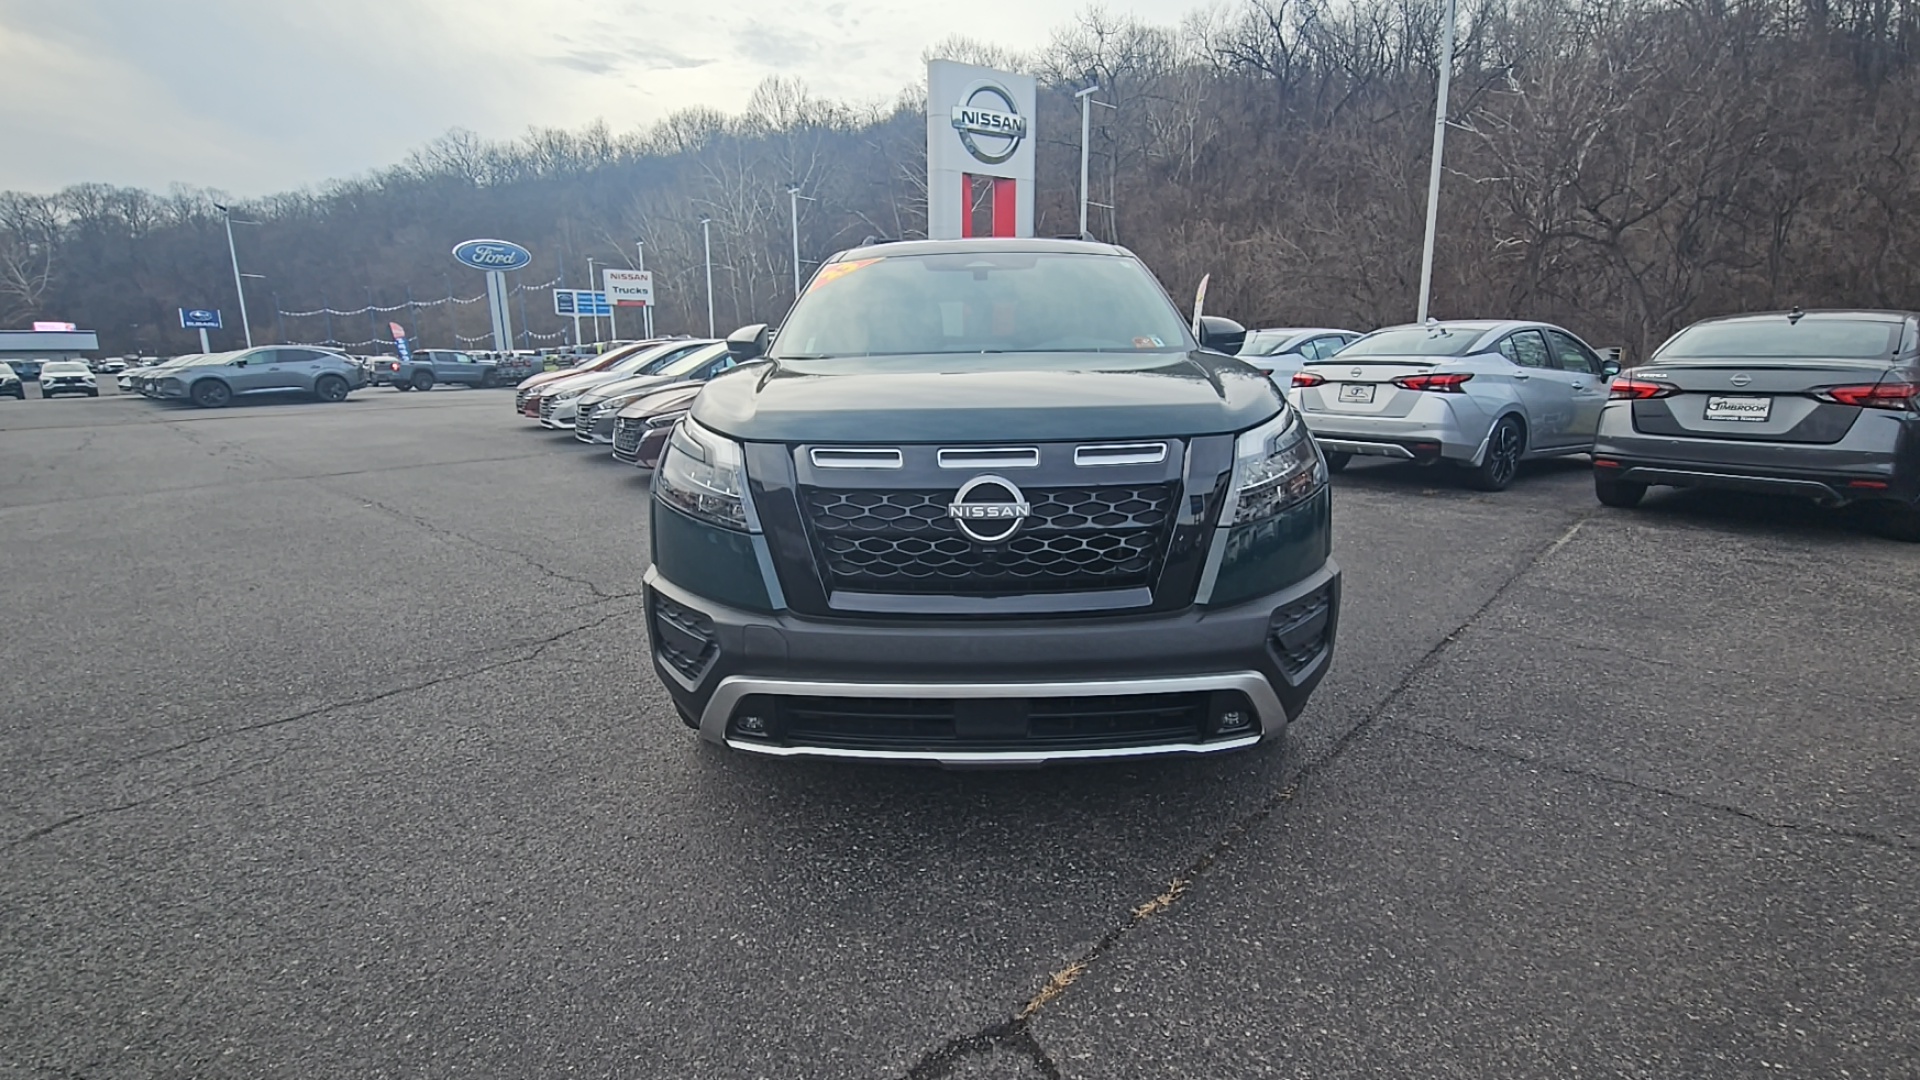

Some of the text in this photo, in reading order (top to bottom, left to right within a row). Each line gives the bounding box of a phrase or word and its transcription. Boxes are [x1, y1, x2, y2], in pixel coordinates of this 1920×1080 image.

[961, 110, 1022, 132] NISSAN
[472, 245, 516, 264] Ford
[610, 273, 648, 281] NISSAN
[612, 286, 649, 295] Trucks
[950, 506, 1028, 517] NISSAN
